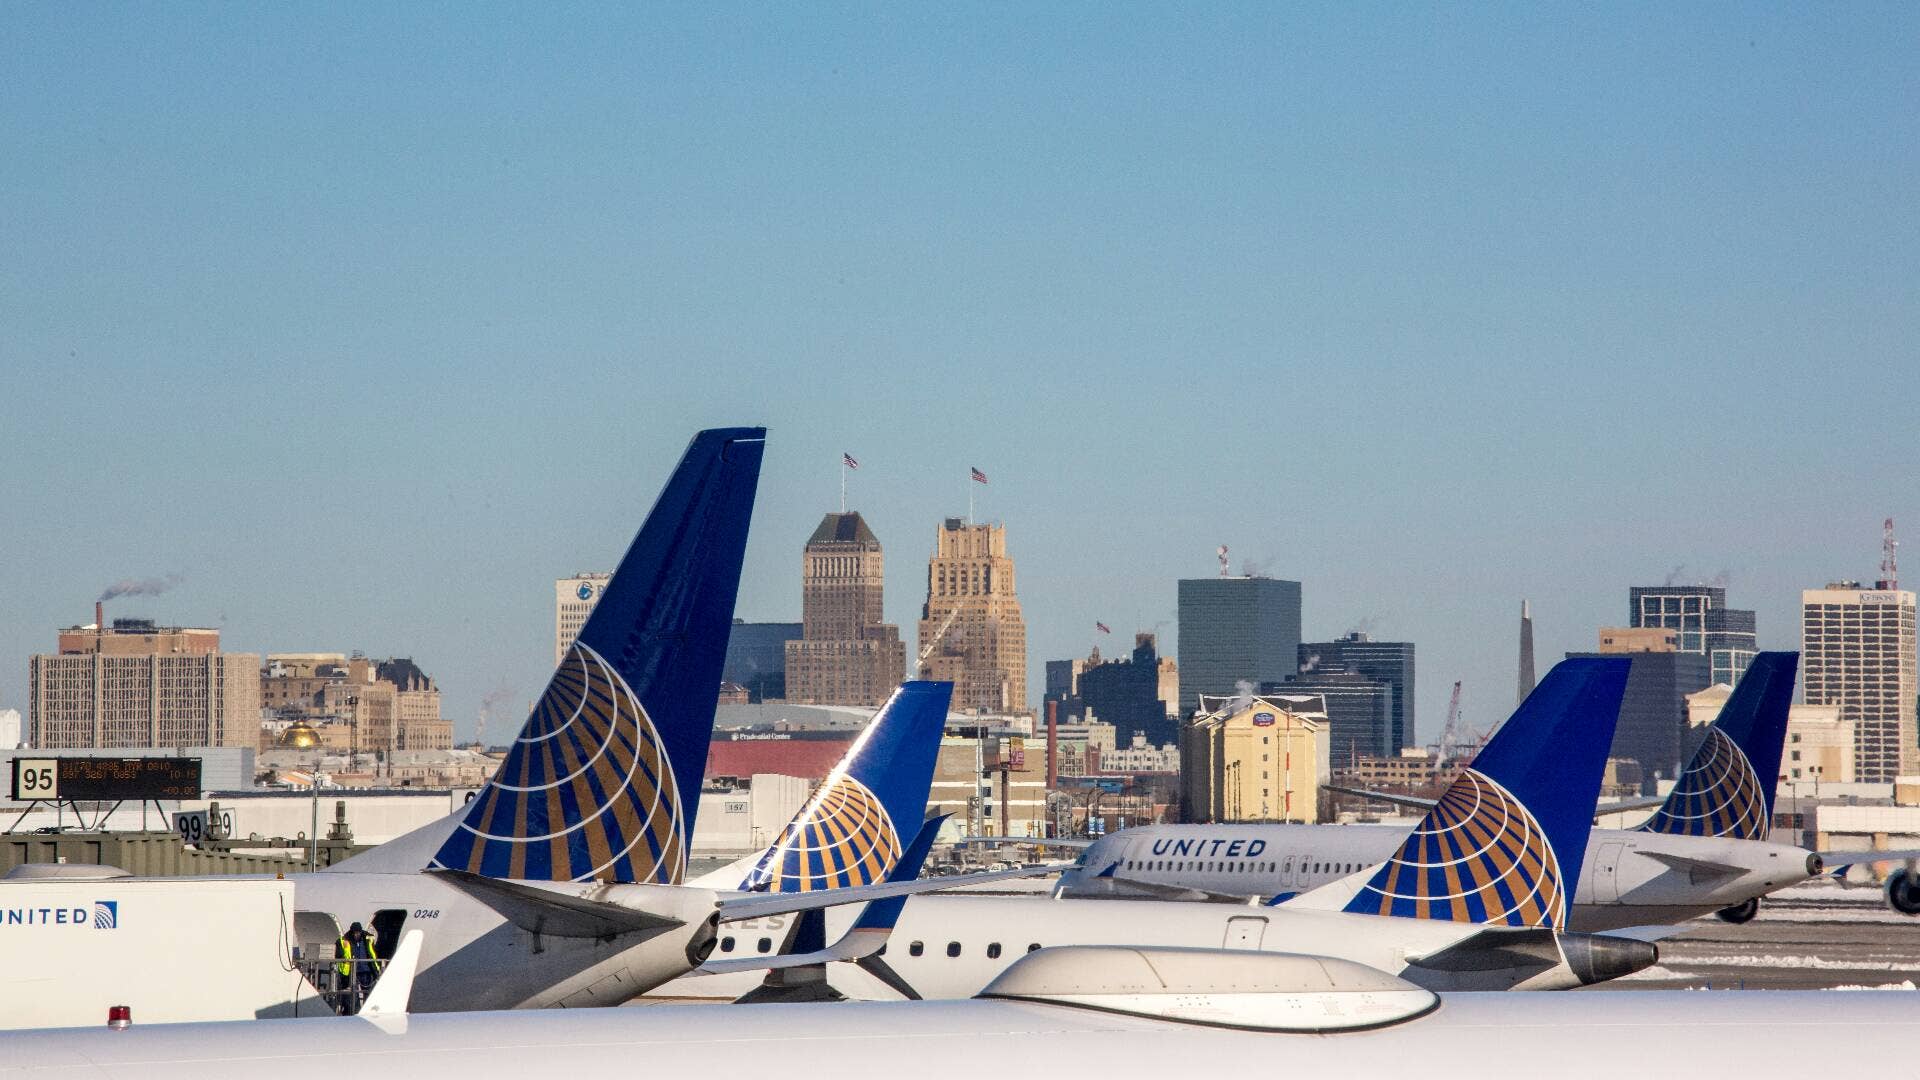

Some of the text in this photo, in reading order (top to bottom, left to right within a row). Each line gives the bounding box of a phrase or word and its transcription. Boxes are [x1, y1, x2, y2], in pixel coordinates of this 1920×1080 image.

[24, 768, 52, 791] 95
[179, 815, 201, 841] 99
[1152, 839, 1267, 857] UNITED
[0, 908, 87, 925] NITED
[414, 909, 440, 919] 0248
